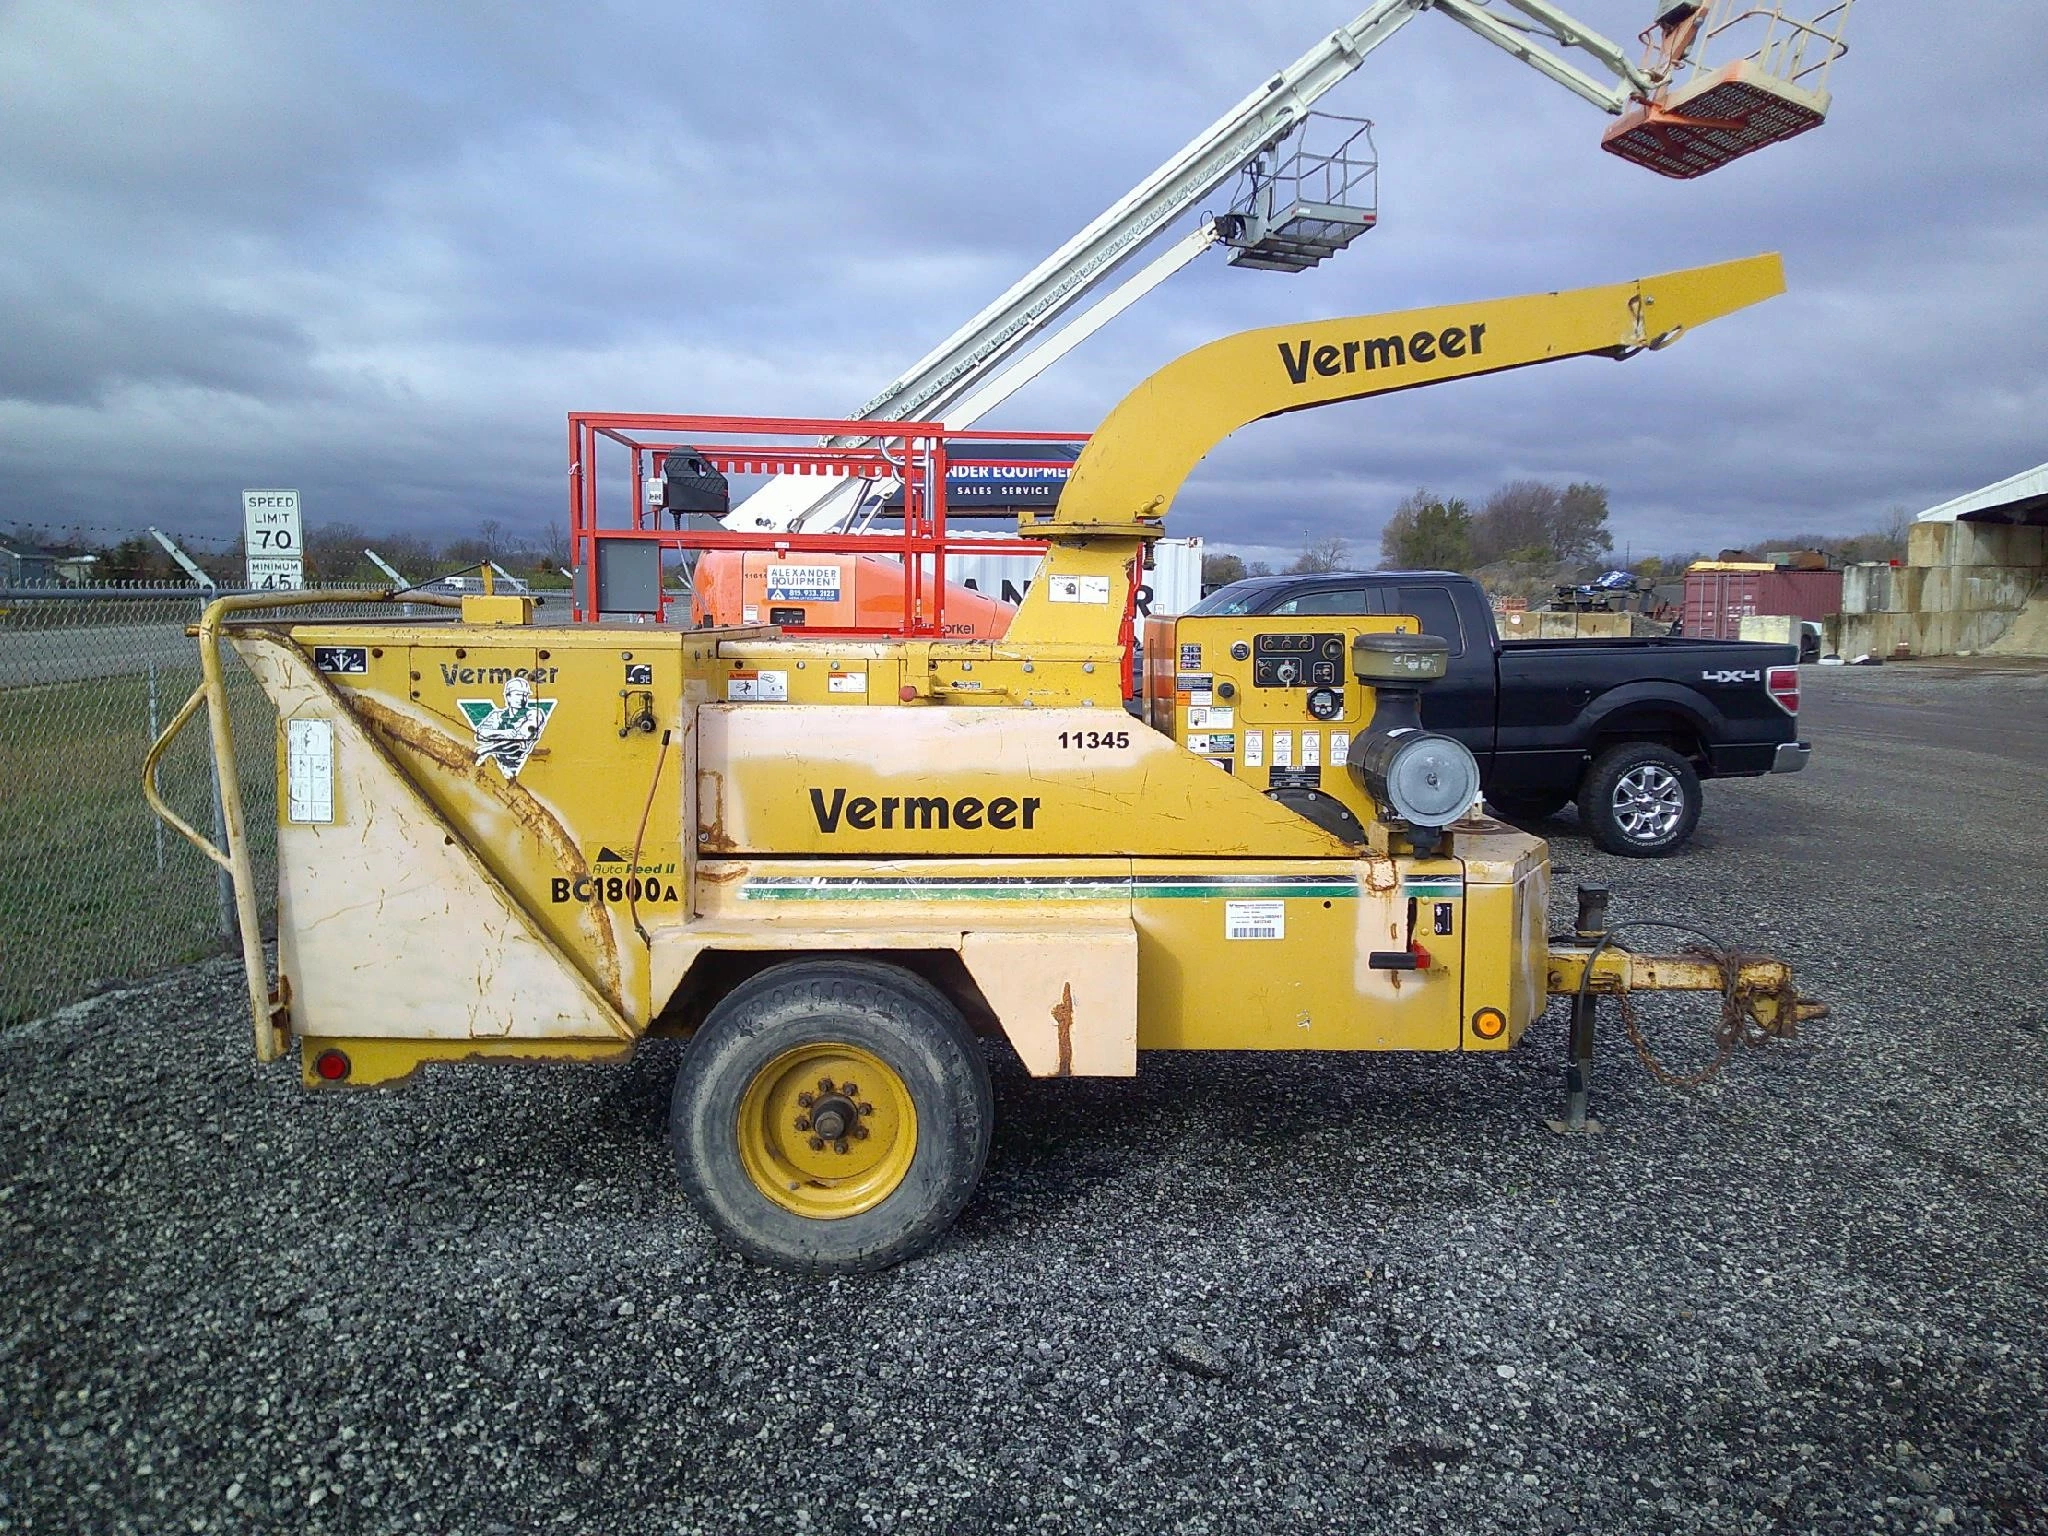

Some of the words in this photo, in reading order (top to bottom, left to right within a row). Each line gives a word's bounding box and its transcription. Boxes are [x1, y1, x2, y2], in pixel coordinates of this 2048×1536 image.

[1277, 322, 1486, 385] Vermeer
[992, 466, 1072, 478] EQUIPME
[957, 486, 992, 495] SALES
[1001, 486, 1049, 495] SERVICE
[248, 497, 294, 508] SPEED
[254, 513, 290, 525] LIMIT
[255, 530, 292, 549] 70
[252, 562, 298, 571] MINIMUM
[771, 568, 836, 577] ALEXANDER
[260, 574, 292, 590] 45
[772, 577, 835, 586] EQUIPMENT
[440, 662, 559, 687] Vermeer
[1057, 731, 1131, 749] 11345
[809, 788, 1041, 834] Vermeer
[592, 863, 623, 874] Auto
[625, 863, 663, 874] Feed
[551, 876, 679, 903] BC1800A
